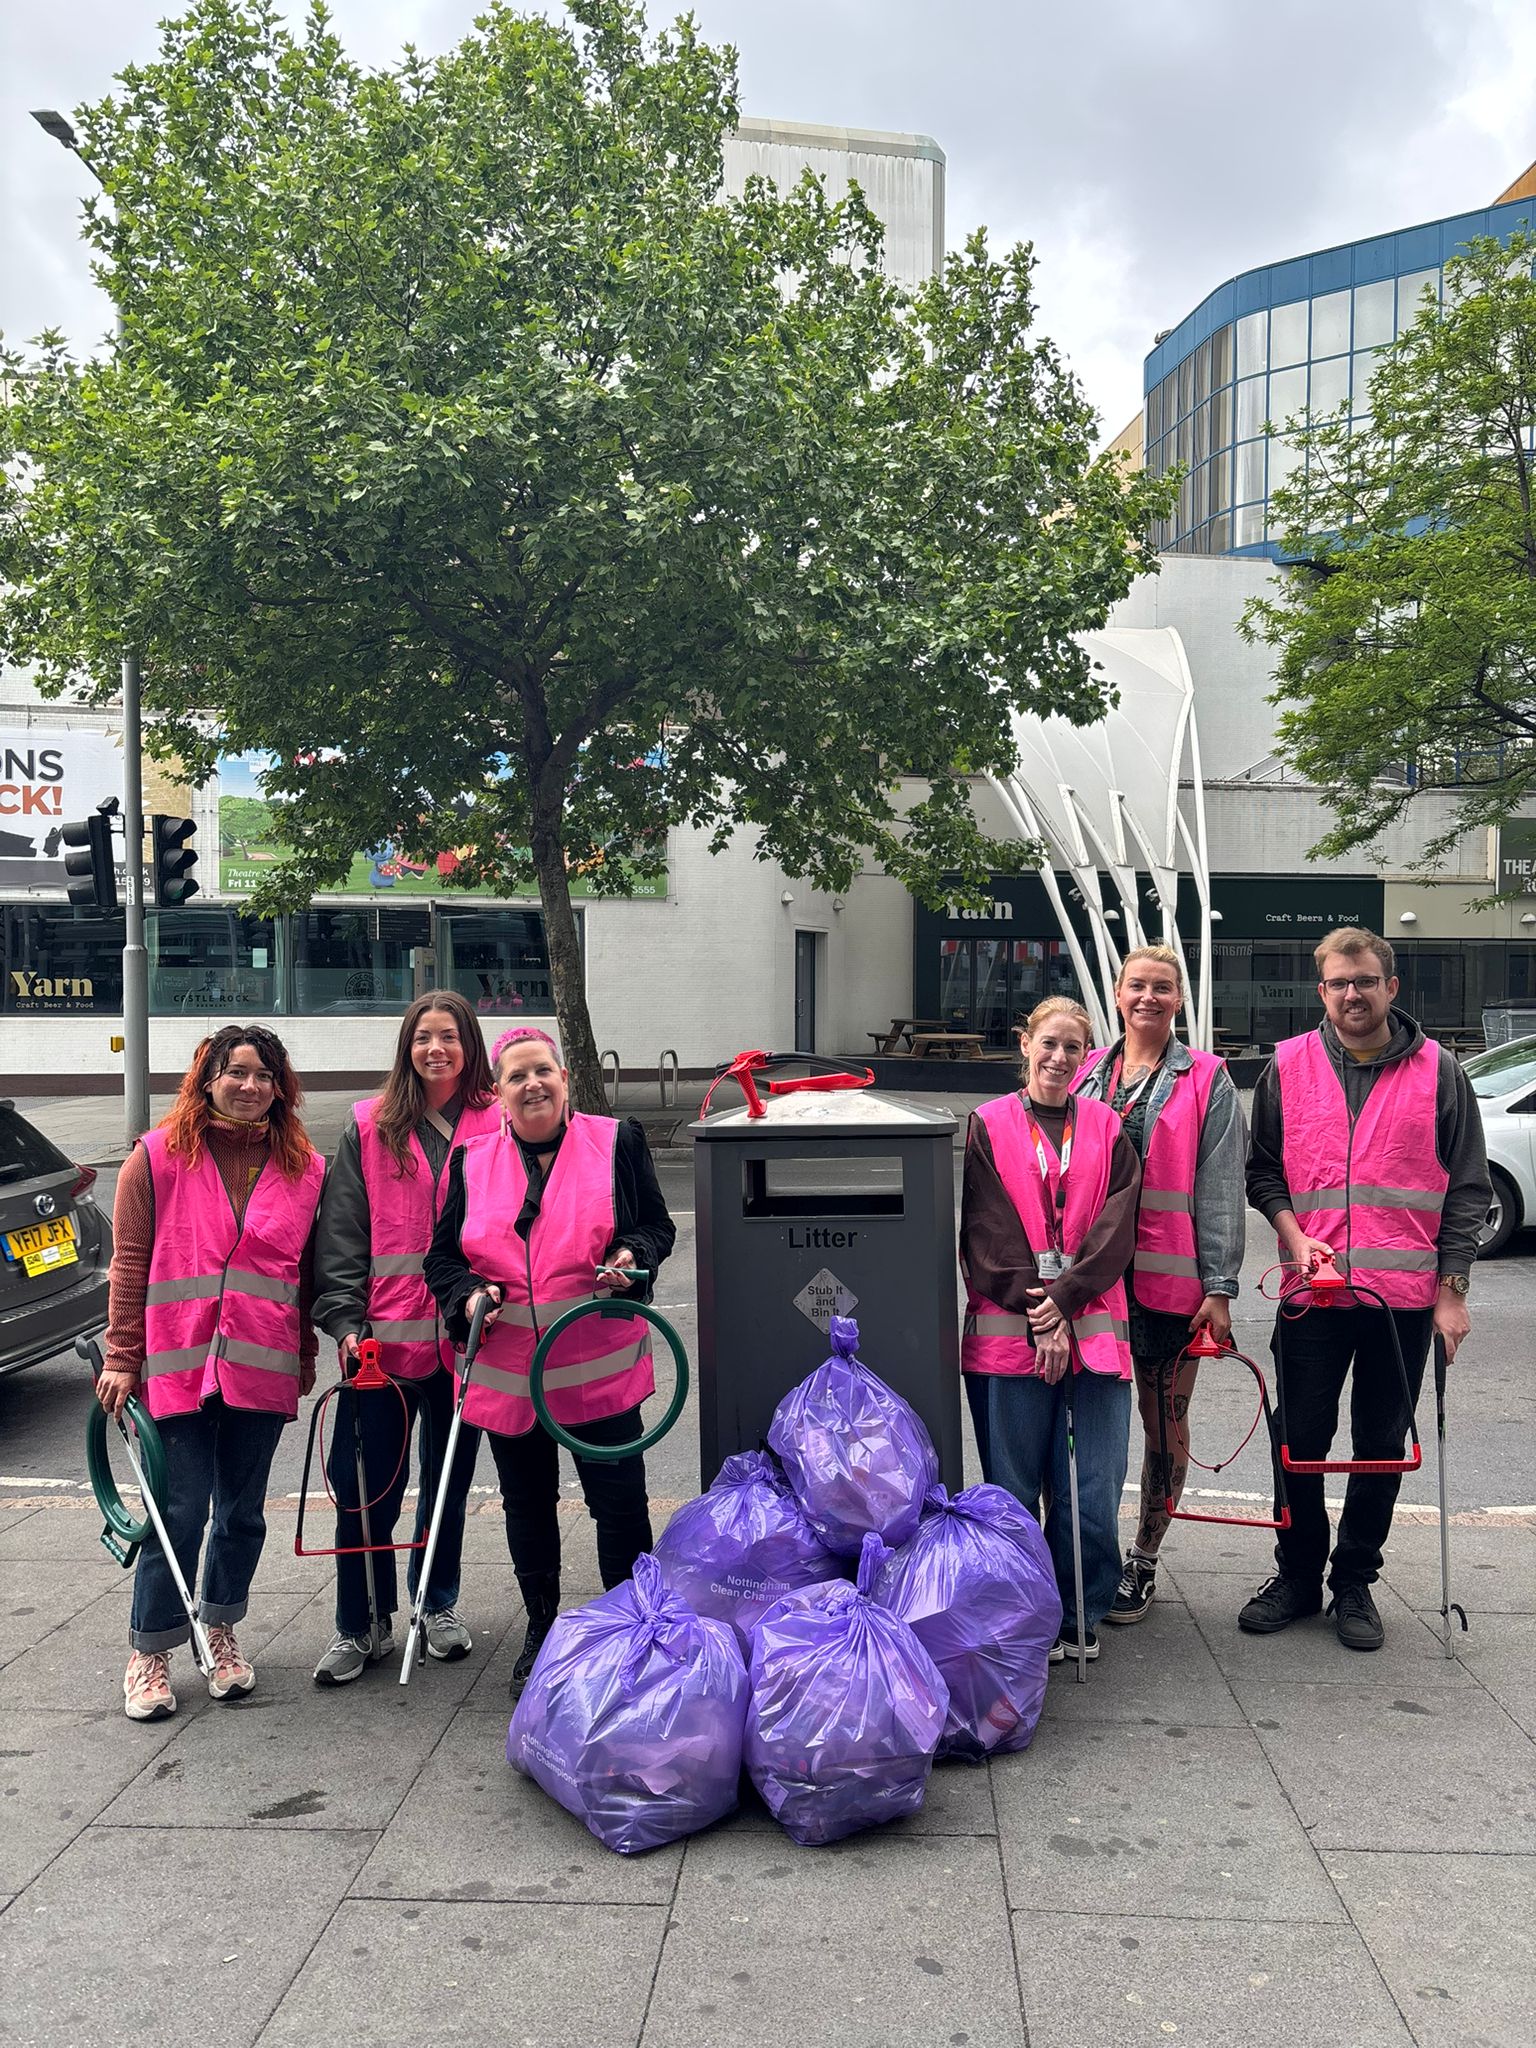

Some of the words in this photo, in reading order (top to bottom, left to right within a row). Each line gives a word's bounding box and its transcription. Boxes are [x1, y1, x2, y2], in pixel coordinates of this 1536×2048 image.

[0, 749, 64, 782] NS
[0, 784, 63, 815] CK!
[227, 868, 261, 878] Theatre
[228, 879, 241, 888] Fri
[244, 879, 257, 888] 11
[1265, 913, 1292, 922] Craft
[1296, 913, 1323, 922] Beers
[1338, 914, 1359, 922] Food
[10, 971, 95, 997] Yarn
[477, 974, 550, 997] Yarn
[219, 994, 250, 1002] ROCK
[1260, 985, 1294, 998] Yarn
[15, 1001, 40, 1009] Craft
[43, 1001, 62, 1009] Beer
[66, 1001, 72, 1009] &
[75, 1001, 94, 1009] Food
[11, 1227, 44, 1252] YF17
[47, 1219, 71, 1243] JFX
[788, 1227, 858, 1248] Litter
[807, 1285, 833, 1295] Stub
[835, 1285, 844, 1295] It
[815, 1297, 836, 1306] and
[811, 1307, 830, 1317] Bin
[832, 1307, 841, 1317] It
[727, 1574, 791, 1592] Nottingham
[710, 1582, 741, 1598] Clean
